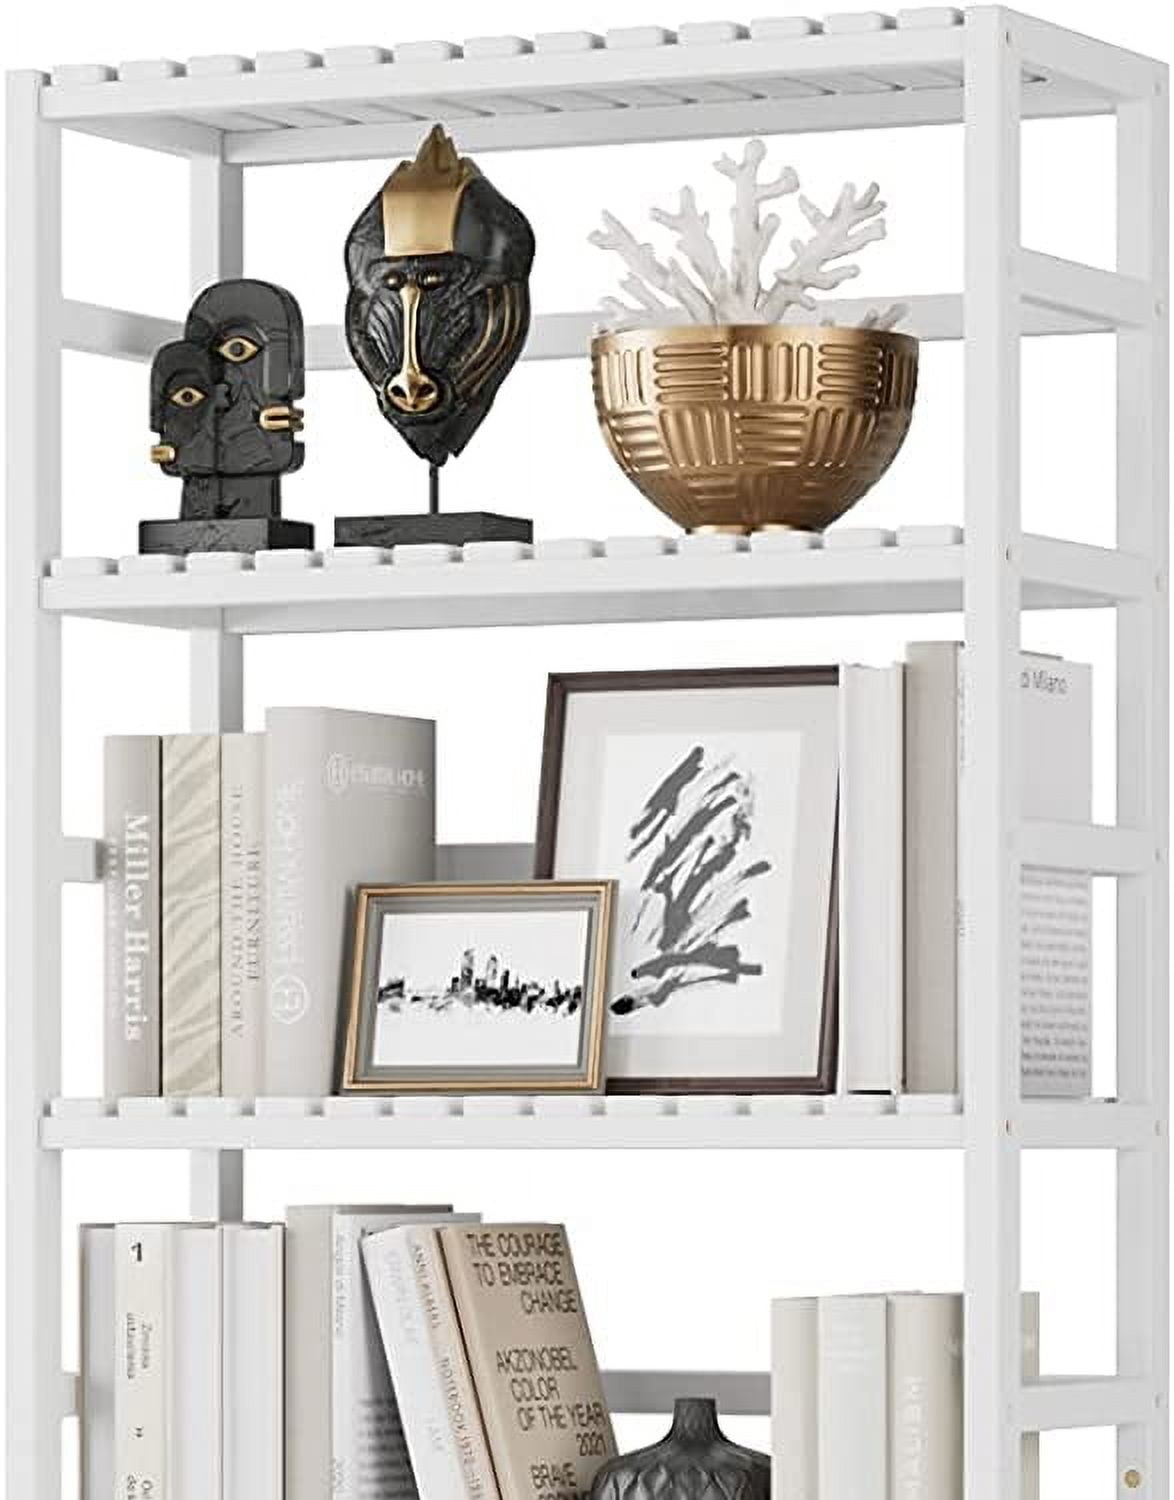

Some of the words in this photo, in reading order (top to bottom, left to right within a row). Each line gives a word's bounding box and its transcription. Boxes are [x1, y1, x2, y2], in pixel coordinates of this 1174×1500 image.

[229, 783, 244, 867] HOUSE
[125, 812, 149, 920] Miller
[229, 879, 244, 925] THE
[246, 848, 261, 982] FURNITURE
[124, 927, 149, 1041] Harris
[229, 934, 244, 1038] AROUND
[467, 1233, 495, 1257] THE
[498, 1231, 565, 1257] COURAGE
[473, 1261, 495, 1287] TO
[498, 1260, 564, 1286] EMBRACE
[520, 1289, 577, 1314] CHANGE
[496, 1346, 578, 1373] AKZONOBEL
[511, 1376, 561, 1402] COLOR
[517, 1406, 537, 1431] OF
[538, 1405, 567, 1429] THE
[566, 1401, 607, 1428] YEAR
[530, 1462, 577, 1489] BRAVE
